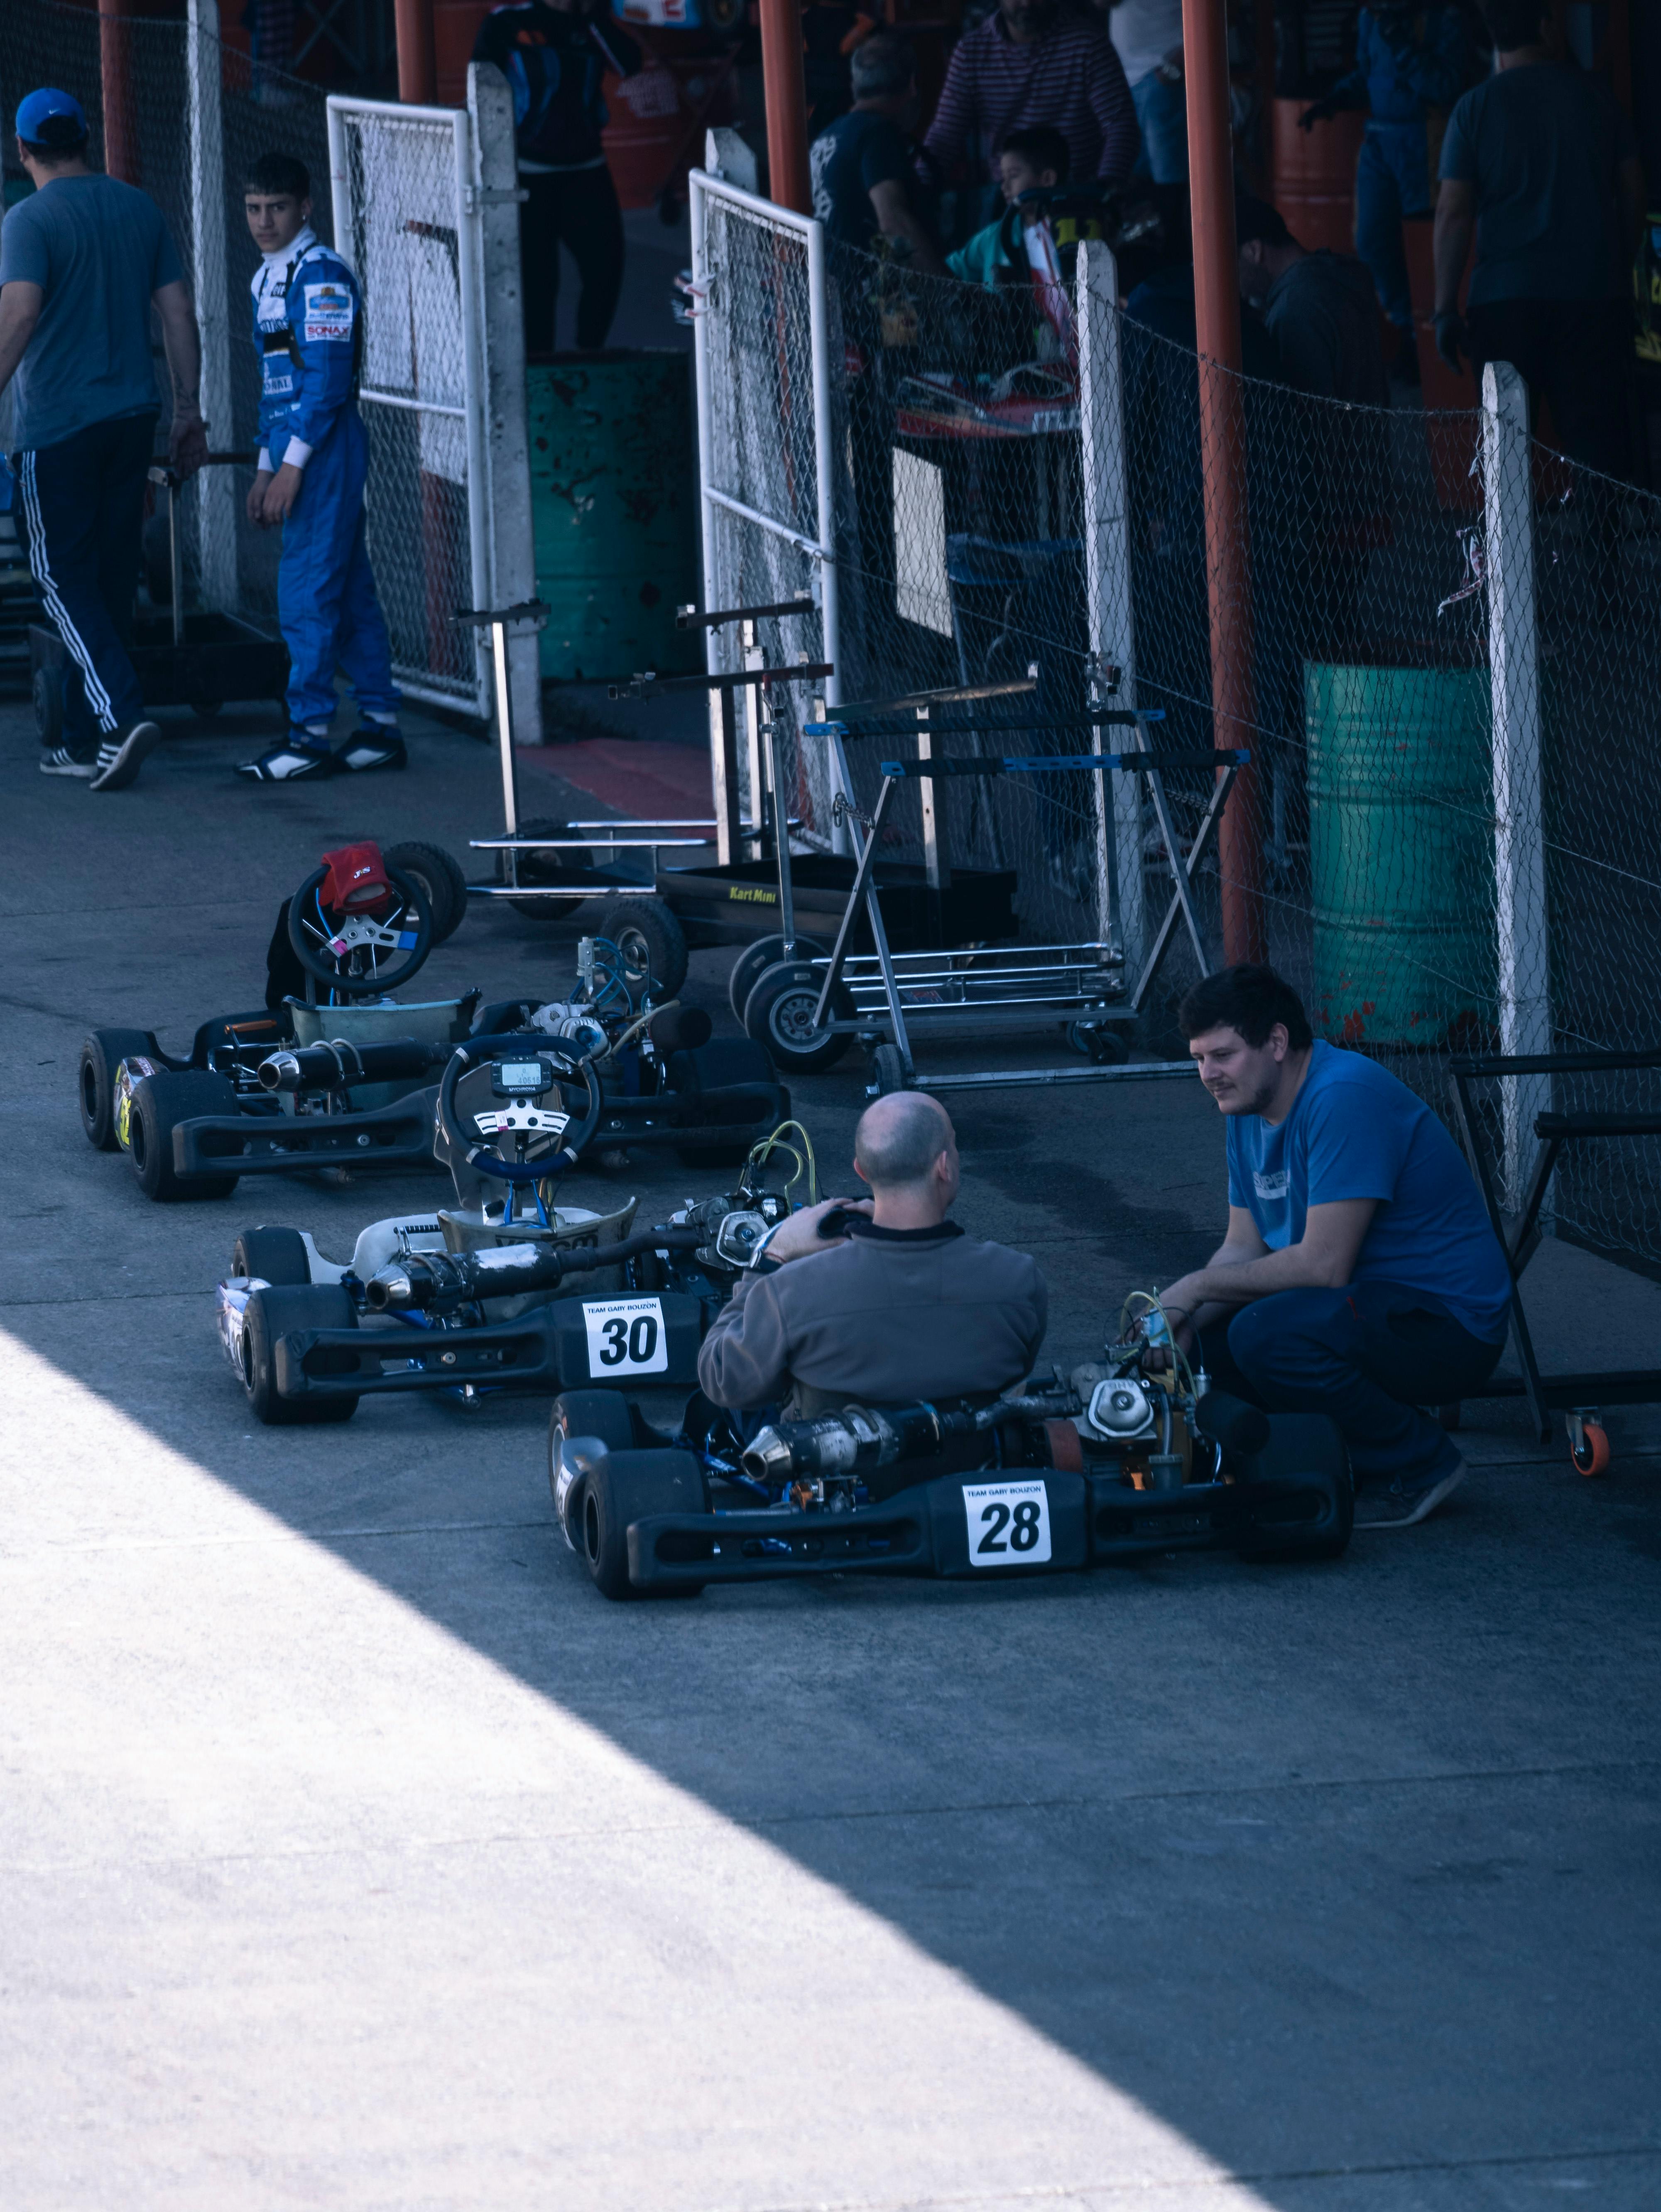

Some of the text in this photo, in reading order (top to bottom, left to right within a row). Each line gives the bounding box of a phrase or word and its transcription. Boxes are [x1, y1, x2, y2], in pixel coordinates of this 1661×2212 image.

[308, 325, 350, 335] SONAX
[600, 1316, 658, 1365] 30
[977, 1500, 1041, 1555] 28
